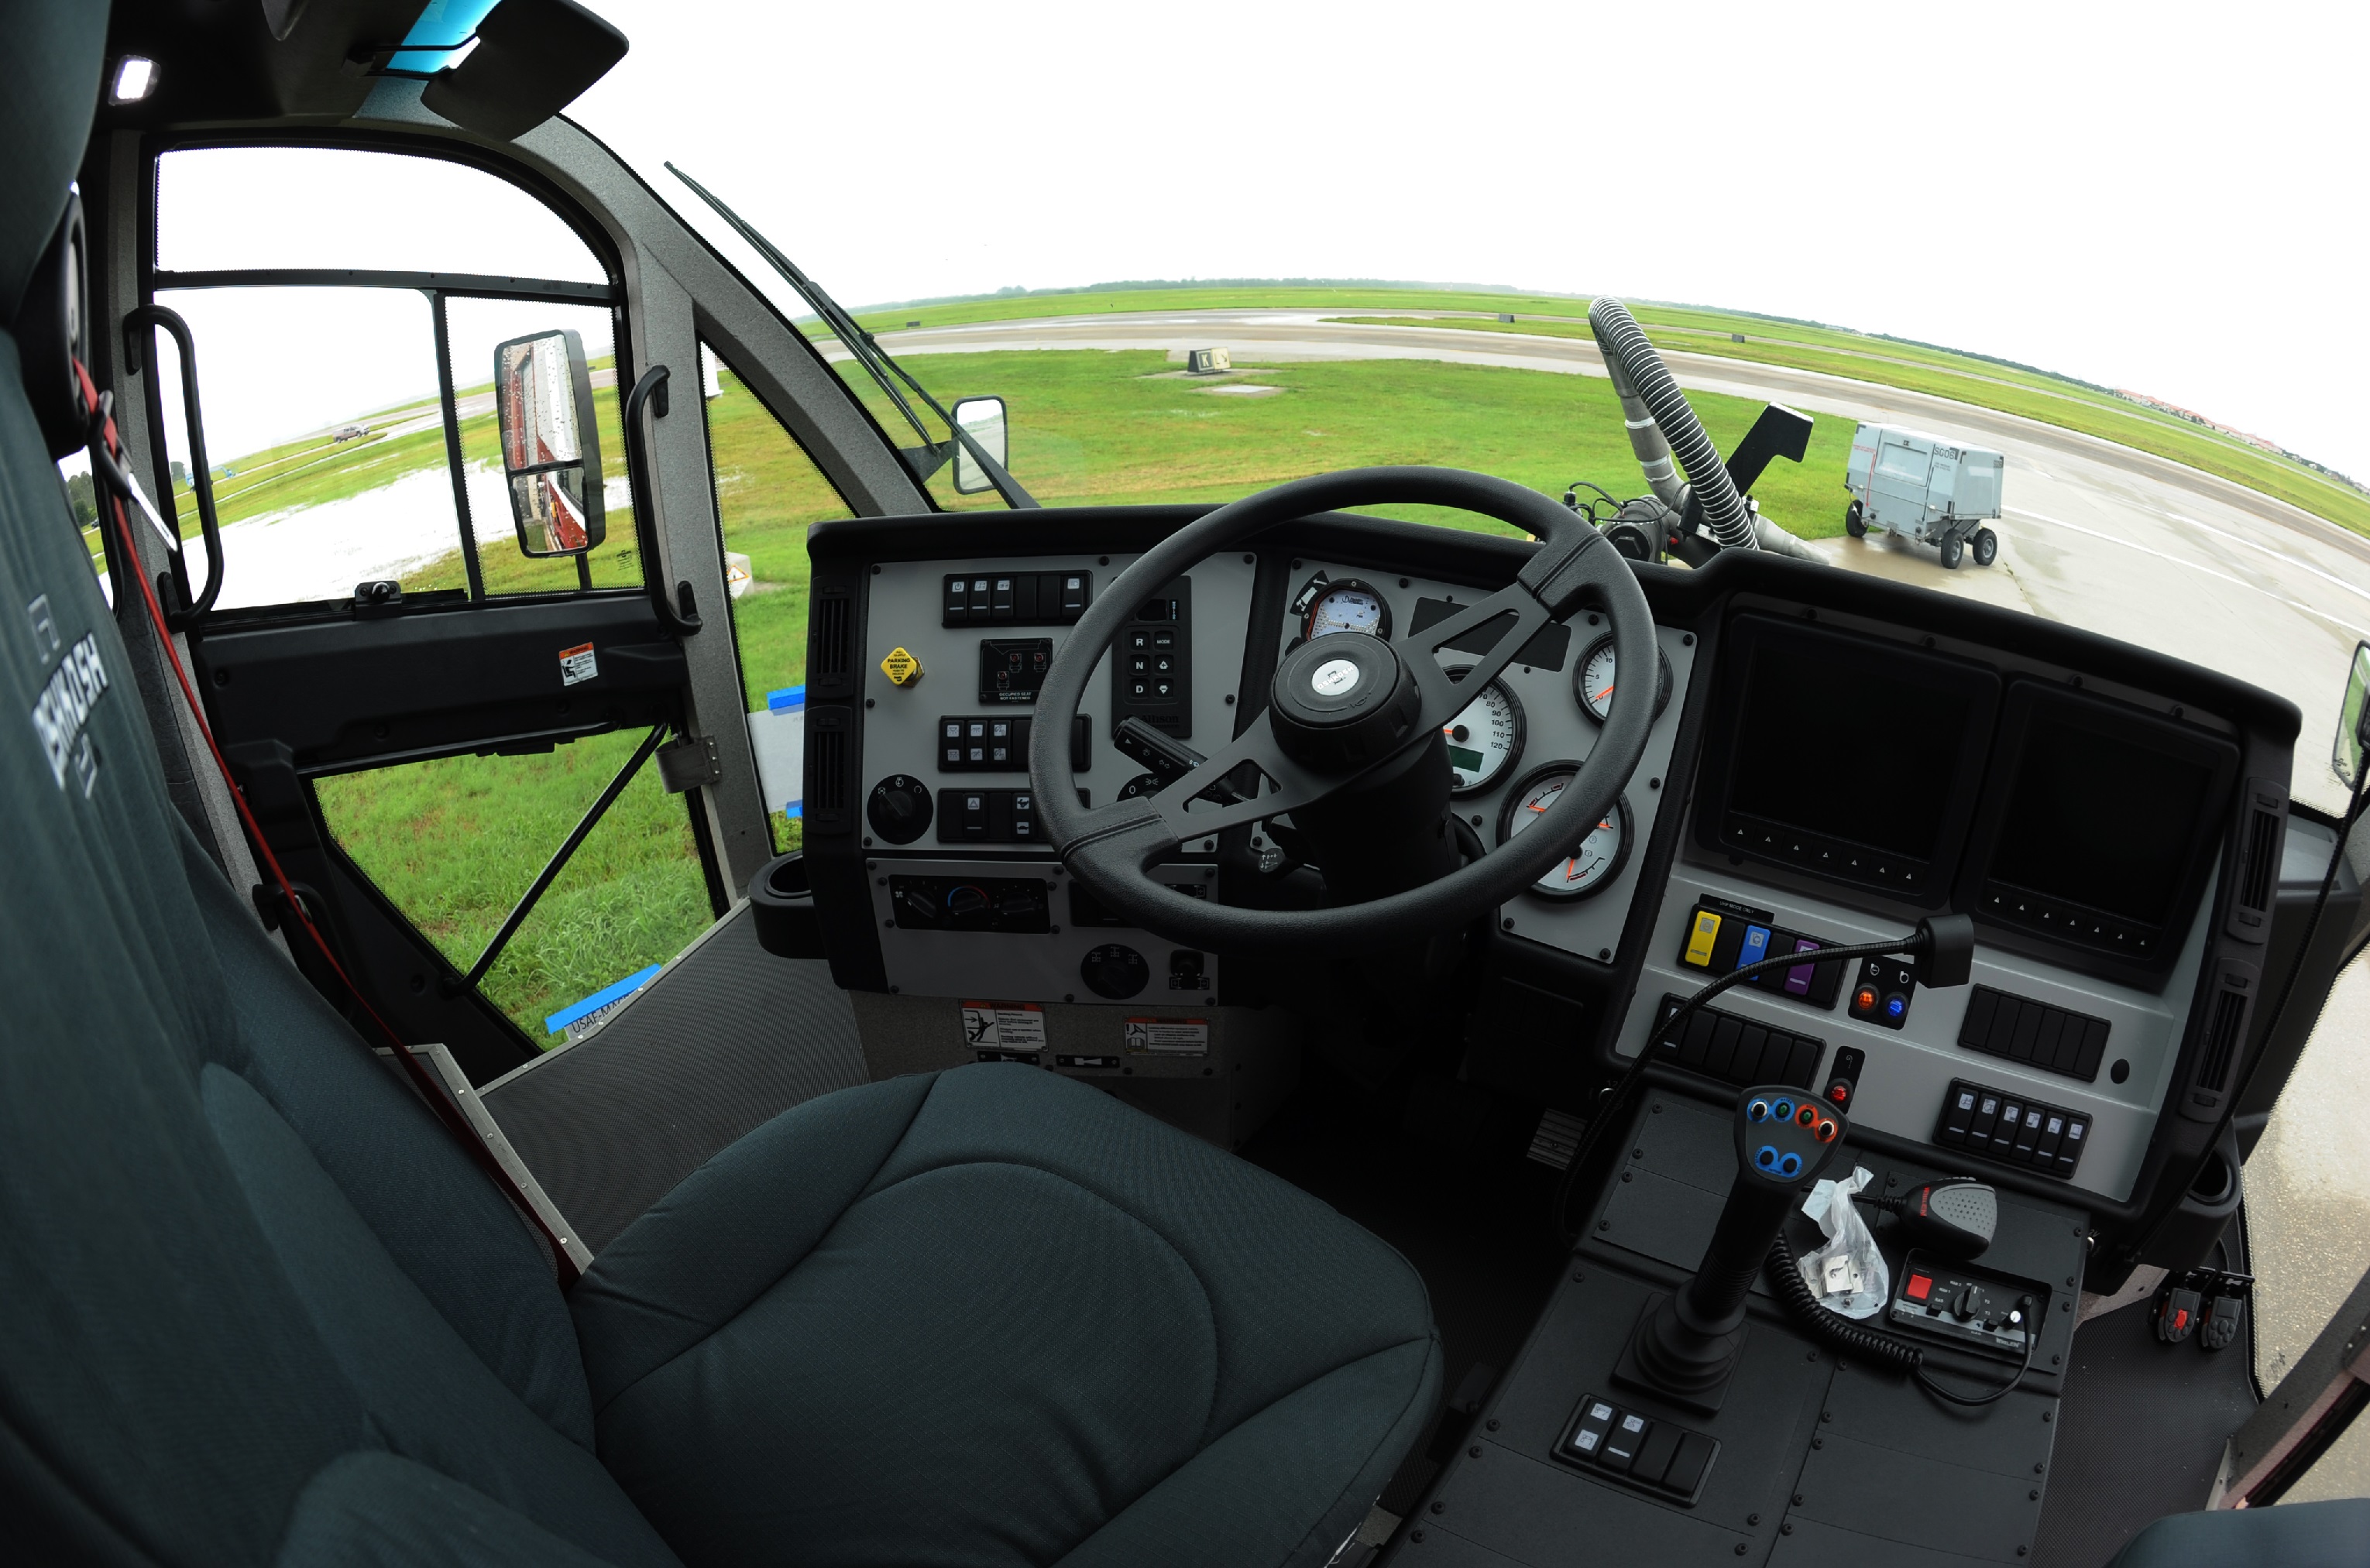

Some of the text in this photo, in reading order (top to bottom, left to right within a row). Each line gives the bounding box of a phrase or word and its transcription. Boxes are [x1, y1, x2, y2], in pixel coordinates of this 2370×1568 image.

[1201, 355, 1210, 367] K
[1135, 638, 1144, 647] R
[1135, 661, 1144, 670] N
[1317, 666, 1355, 690] OSHKOSH
[1135, 685, 1144, 694] D
